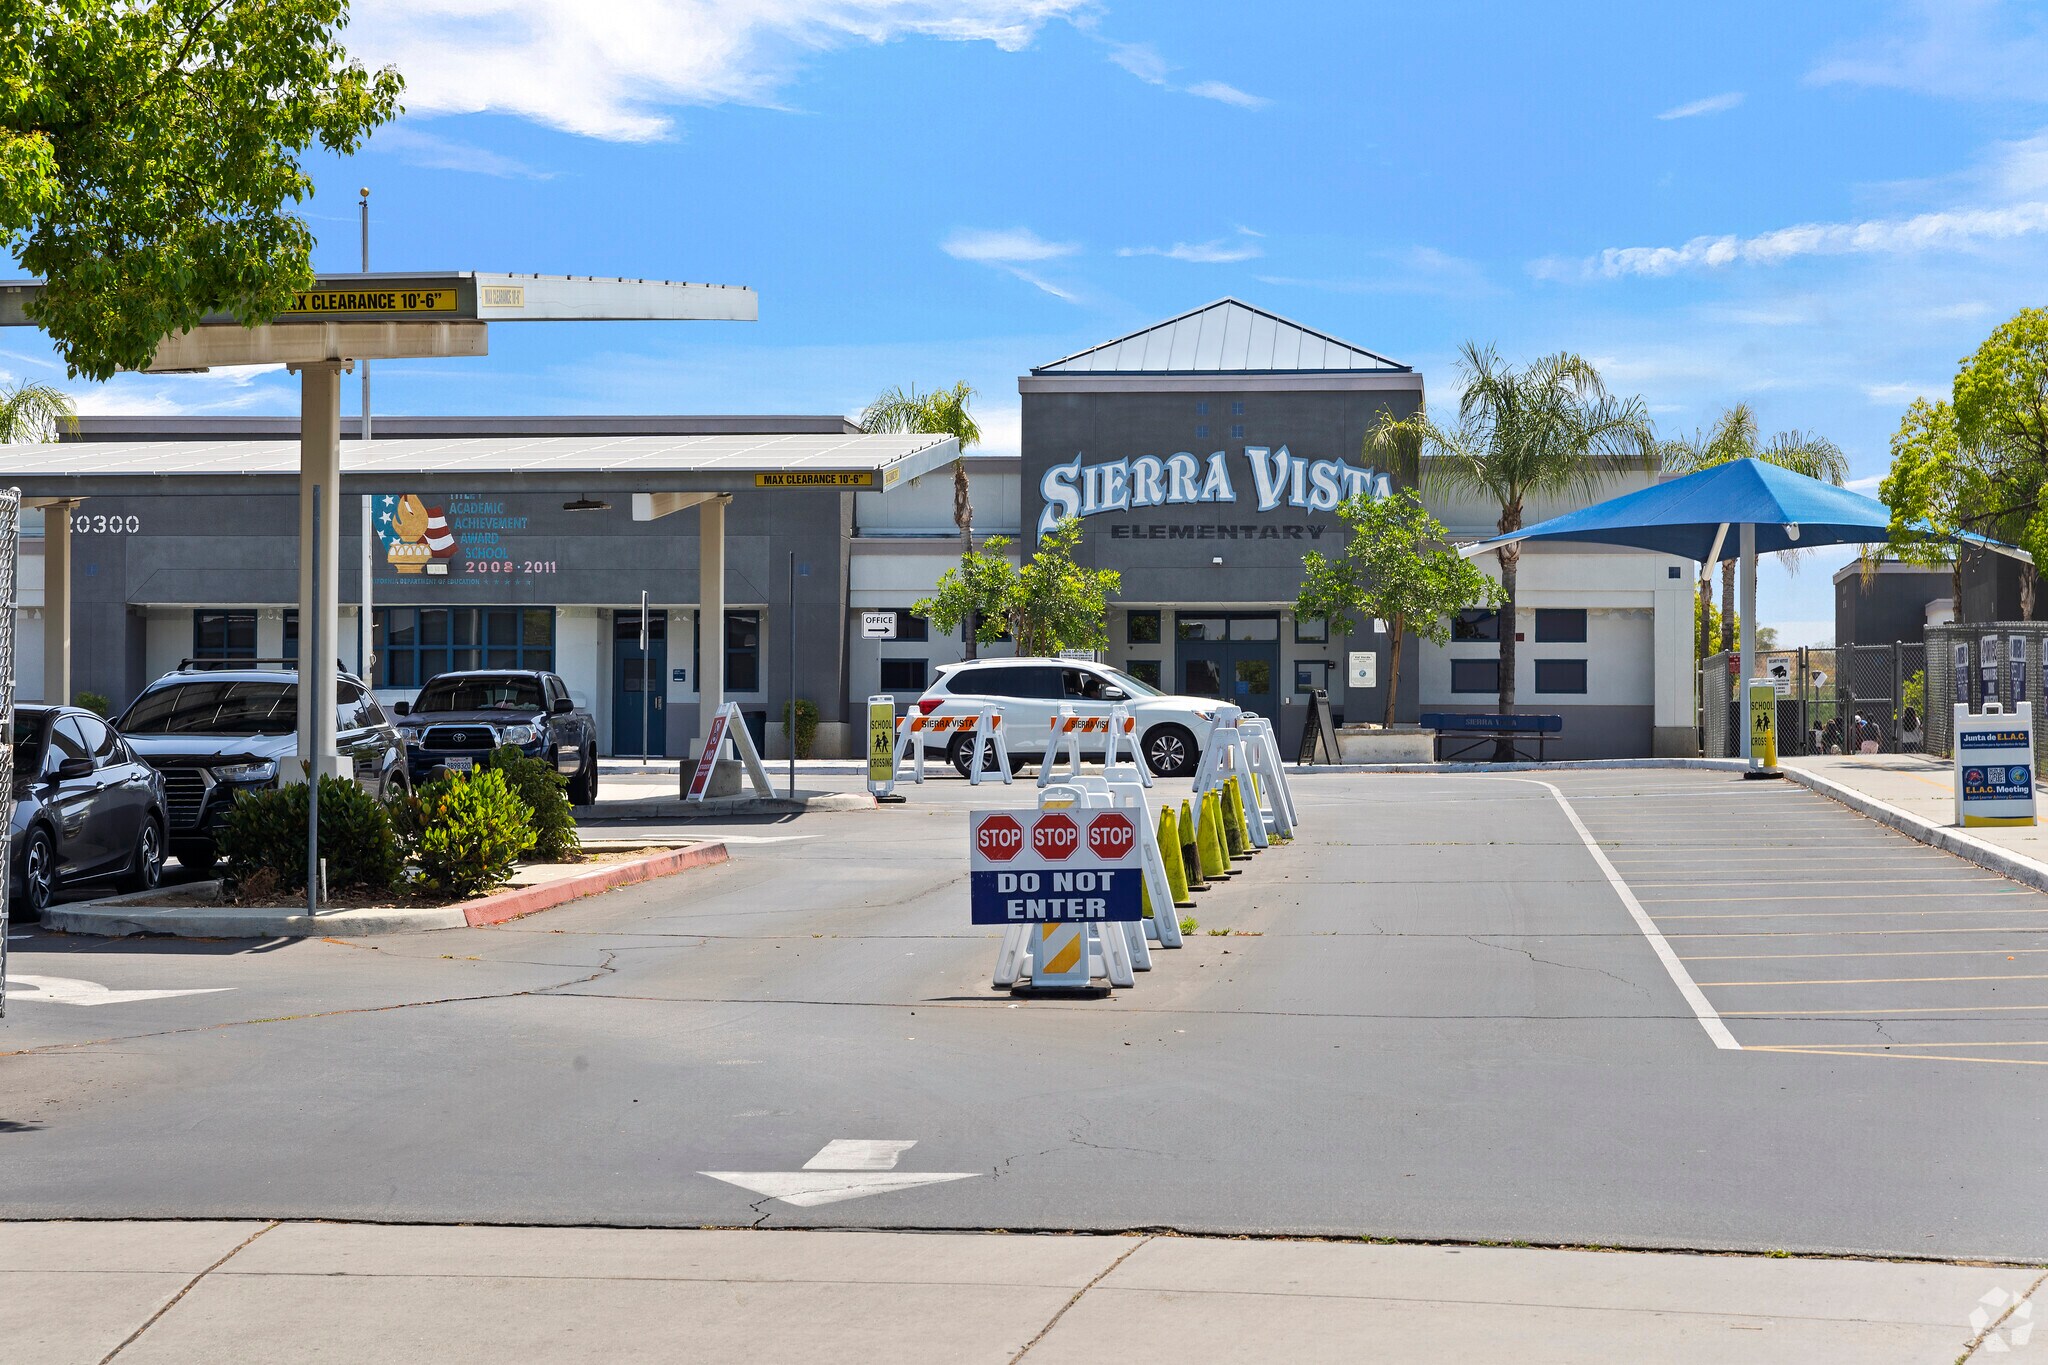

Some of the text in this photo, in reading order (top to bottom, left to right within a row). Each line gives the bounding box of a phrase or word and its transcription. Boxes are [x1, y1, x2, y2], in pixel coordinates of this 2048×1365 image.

[312, 293, 396, 311] CLEARANCE
[764, 474, 784, 485] MAX
[786, 474, 836, 484] CLEARANCE
[1037, 444, 1395, 550] SIERRA VISTA
[449, 502, 504, 514] ACADEMIC
[70, 515, 140, 534] 0300
[454, 517, 528, 529] ACHIEVEMENT
[460, 532, 499, 544] AWARD
[1111, 524, 1329, 540] ELEMENTARY
[465, 547, 509, 559] SCHOOL
[465, 560, 557, 574] 2008 2011
[865, 616, 893, 624] OFFICE
[1751, 701, 1774, 711] SCHOOL
[870, 720, 892, 730] SCHOOL
[921, 719, 975, 729] SIERRA VISTA
[1071, 720, 1094, 729] SIERRA
[1465, 718, 1493, 726] SIERRA
[1963, 733, 2027, 742] Junta de E.L.A.C.
[703, 750, 715, 761] NO
[870, 758, 893, 768] CROSSING
[1965, 785, 2029, 794] E.L.A.C. Meeting
[979, 827, 1132, 847] STOP STOP STOP
[997, 871, 1115, 893] DO NOT
[1007, 898, 1106, 920] ENTER
